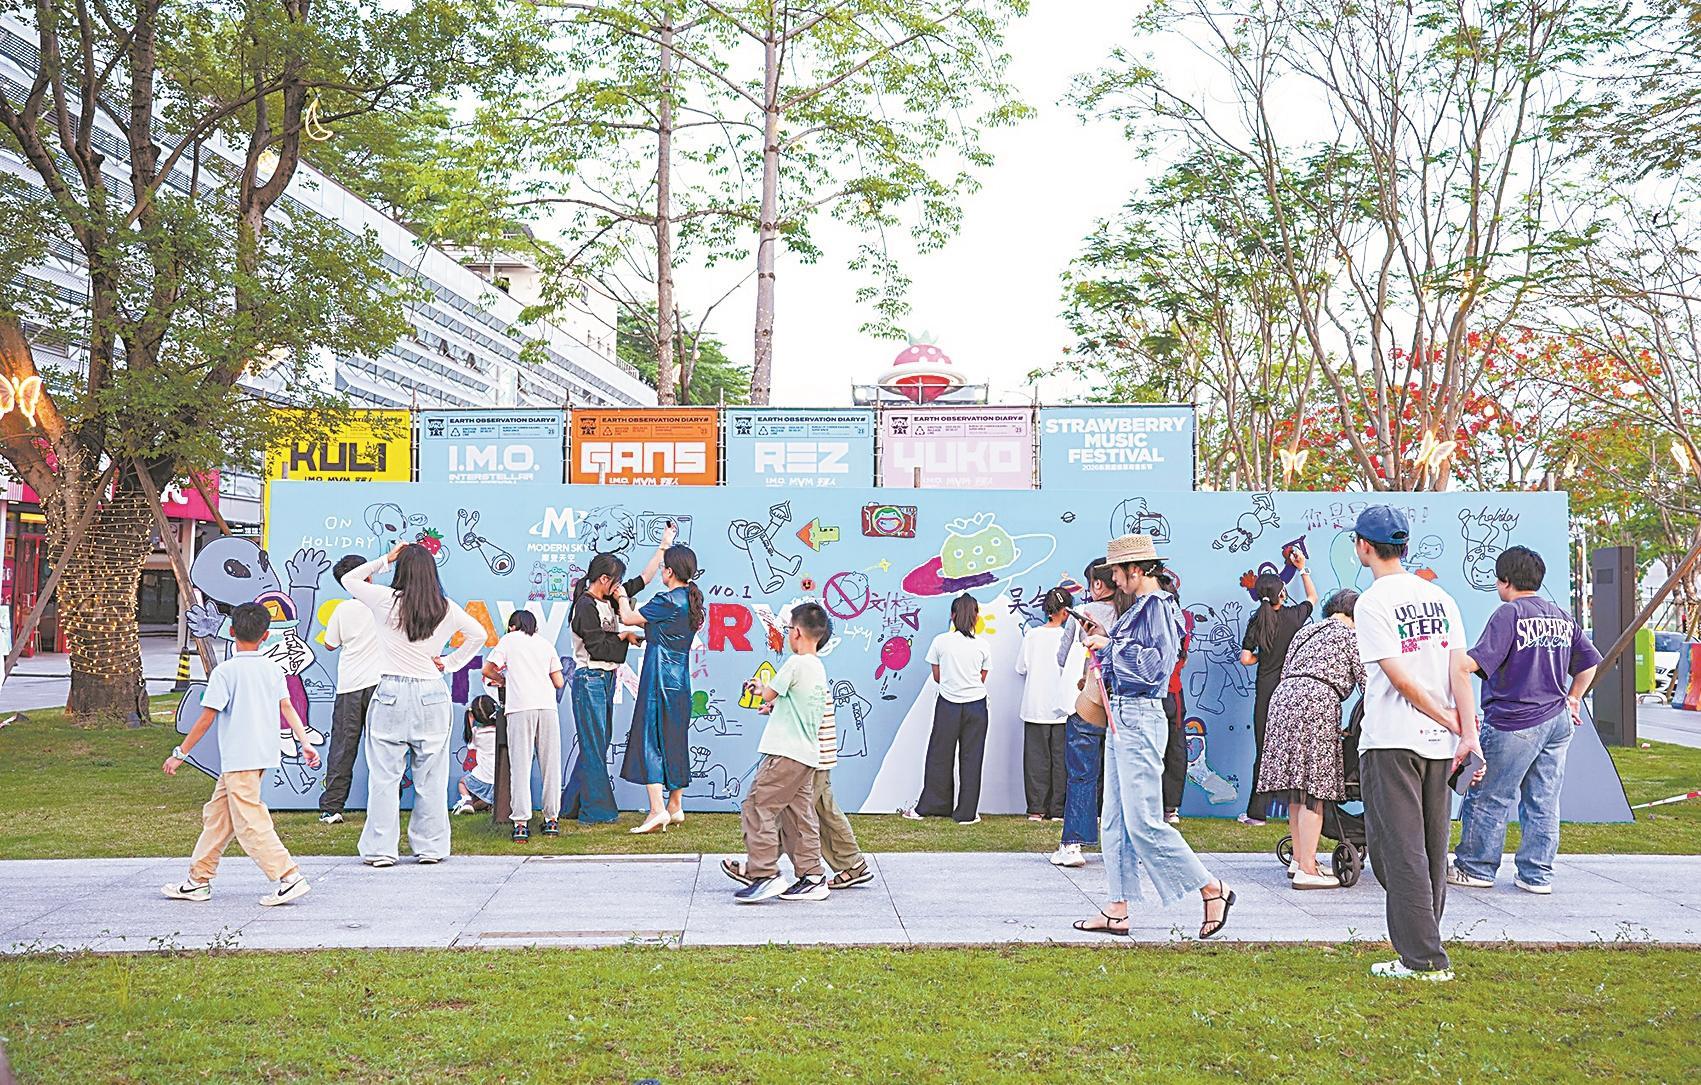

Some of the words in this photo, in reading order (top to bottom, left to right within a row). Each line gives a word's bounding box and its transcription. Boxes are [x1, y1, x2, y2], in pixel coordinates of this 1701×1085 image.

[1045, 416, 1187, 433] STRAWBERRY
[1084, 432, 1148, 448] MUSIC
[290, 442, 387, 472] KULI
[449, 444, 540, 471] I.M.O.
[580, 442, 706, 473] GANS
[755, 442, 849, 473] REZ
[894, 441, 1022, 473] YUKO
[1068, 447, 1165, 464] FESTIVAL
[324, 516, 352, 530] ON
[301, 535, 376, 549] HOLIDAY
[527, 543, 570, 553] MODERN
[570, 543, 590, 553] SKY
[708, 584, 752, 599] NO.1
